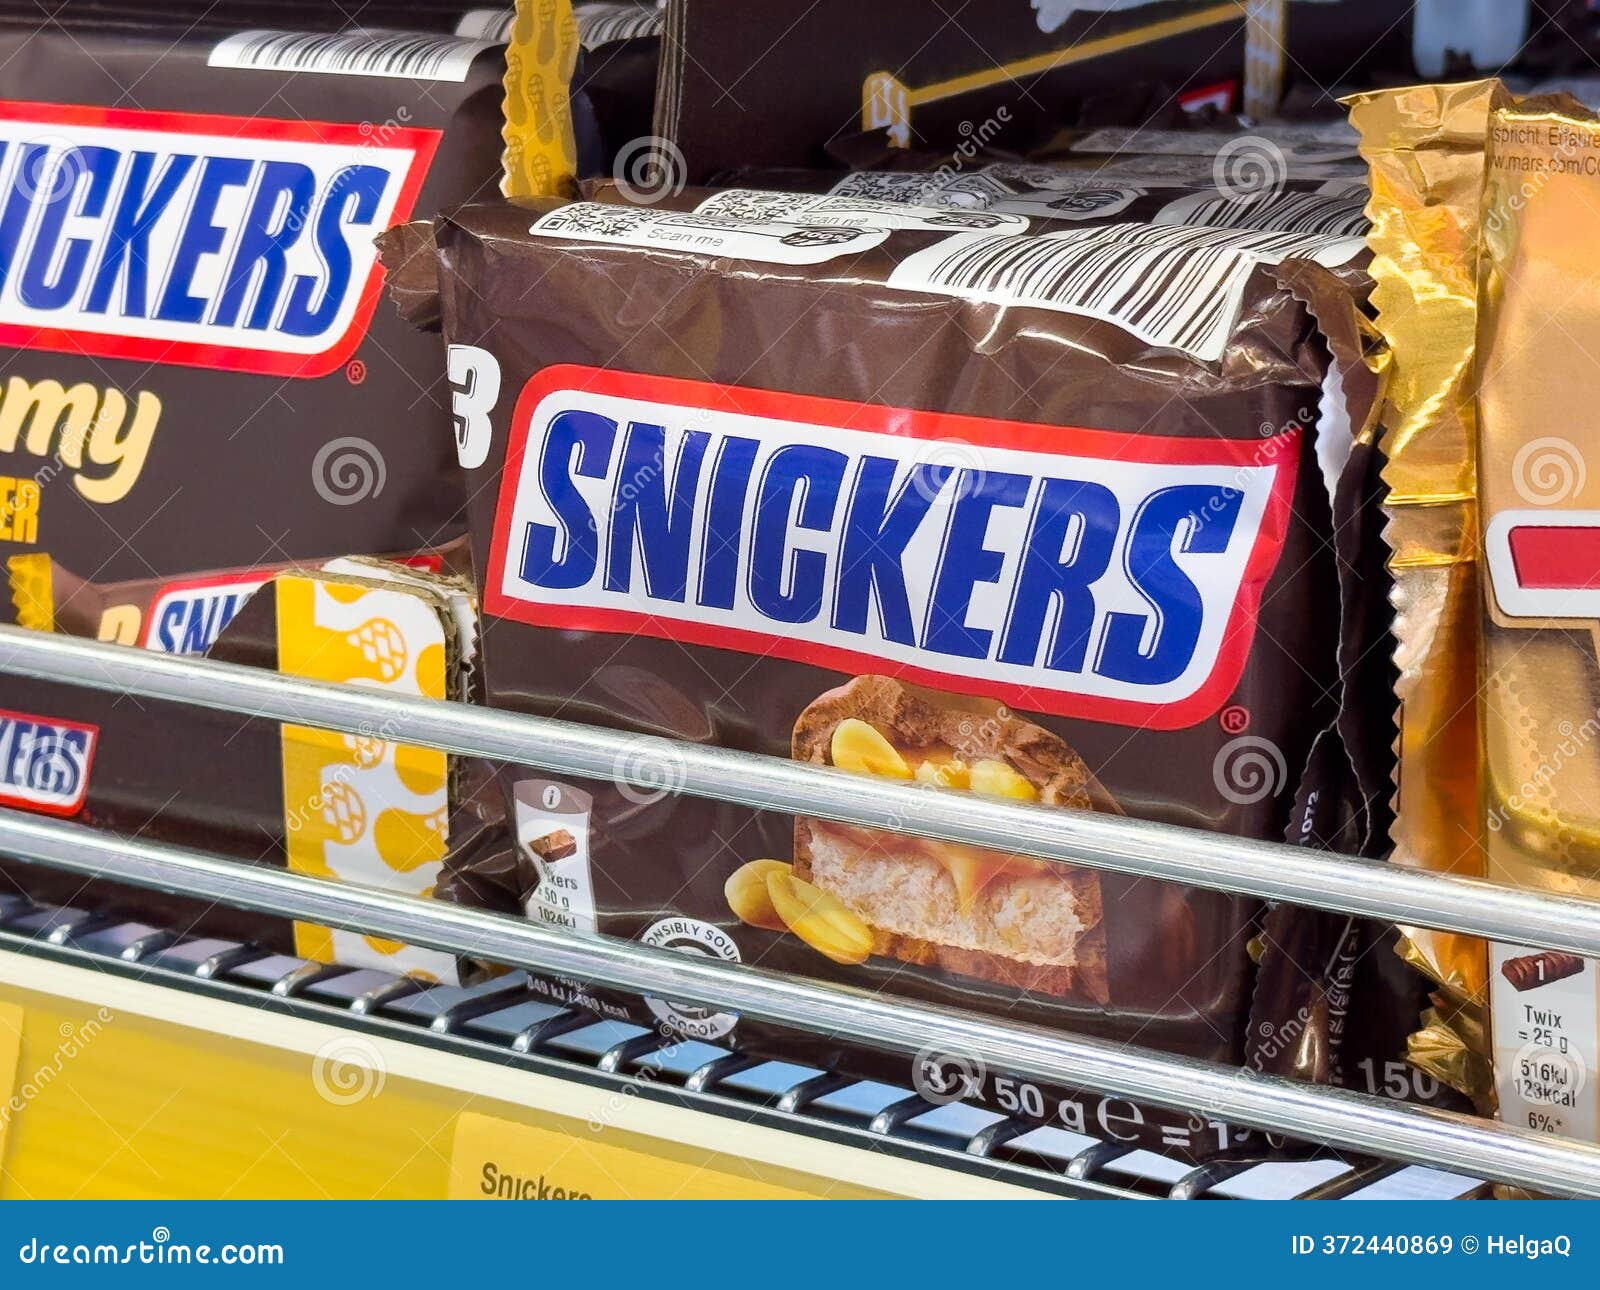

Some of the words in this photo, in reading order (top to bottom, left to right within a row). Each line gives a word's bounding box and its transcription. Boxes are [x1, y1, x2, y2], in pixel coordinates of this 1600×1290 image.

[1492, 126, 1543, 146] spricht.
[0, 139, 391, 339] ICKERS
[647, 228, 692, 242] Scan
[694, 234, 724, 247] me
[447, 344, 501, 469] 3
[0, 376, 162, 503] my
[0, 476, 41, 545] ER
[519, 409, 1244, 685] SNICKERS
[158, 592, 252, 655] SNI
[544, 886, 558, 905] 50
[646, 922, 700, 945] ONSIBLY
[1535, 959, 1545, 981] 1
[667, 1013, 720, 1037] COCOA
[1524, 1005, 1562, 1029] Twix
[1533, 1027, 1553, 1047] 25
[1559, 1036, 1568, 1054] g
[1357, 1057, 1440, 1101] 150
[1520, 1059, 1568, 1086] 516kJ
[919, 1060, 946, 1095] 3
[960, 1073, 986, 1102] x
[994, 1077, 1045, 1118] 50
[1514, 1078, 1576, 1108] 123kcal
